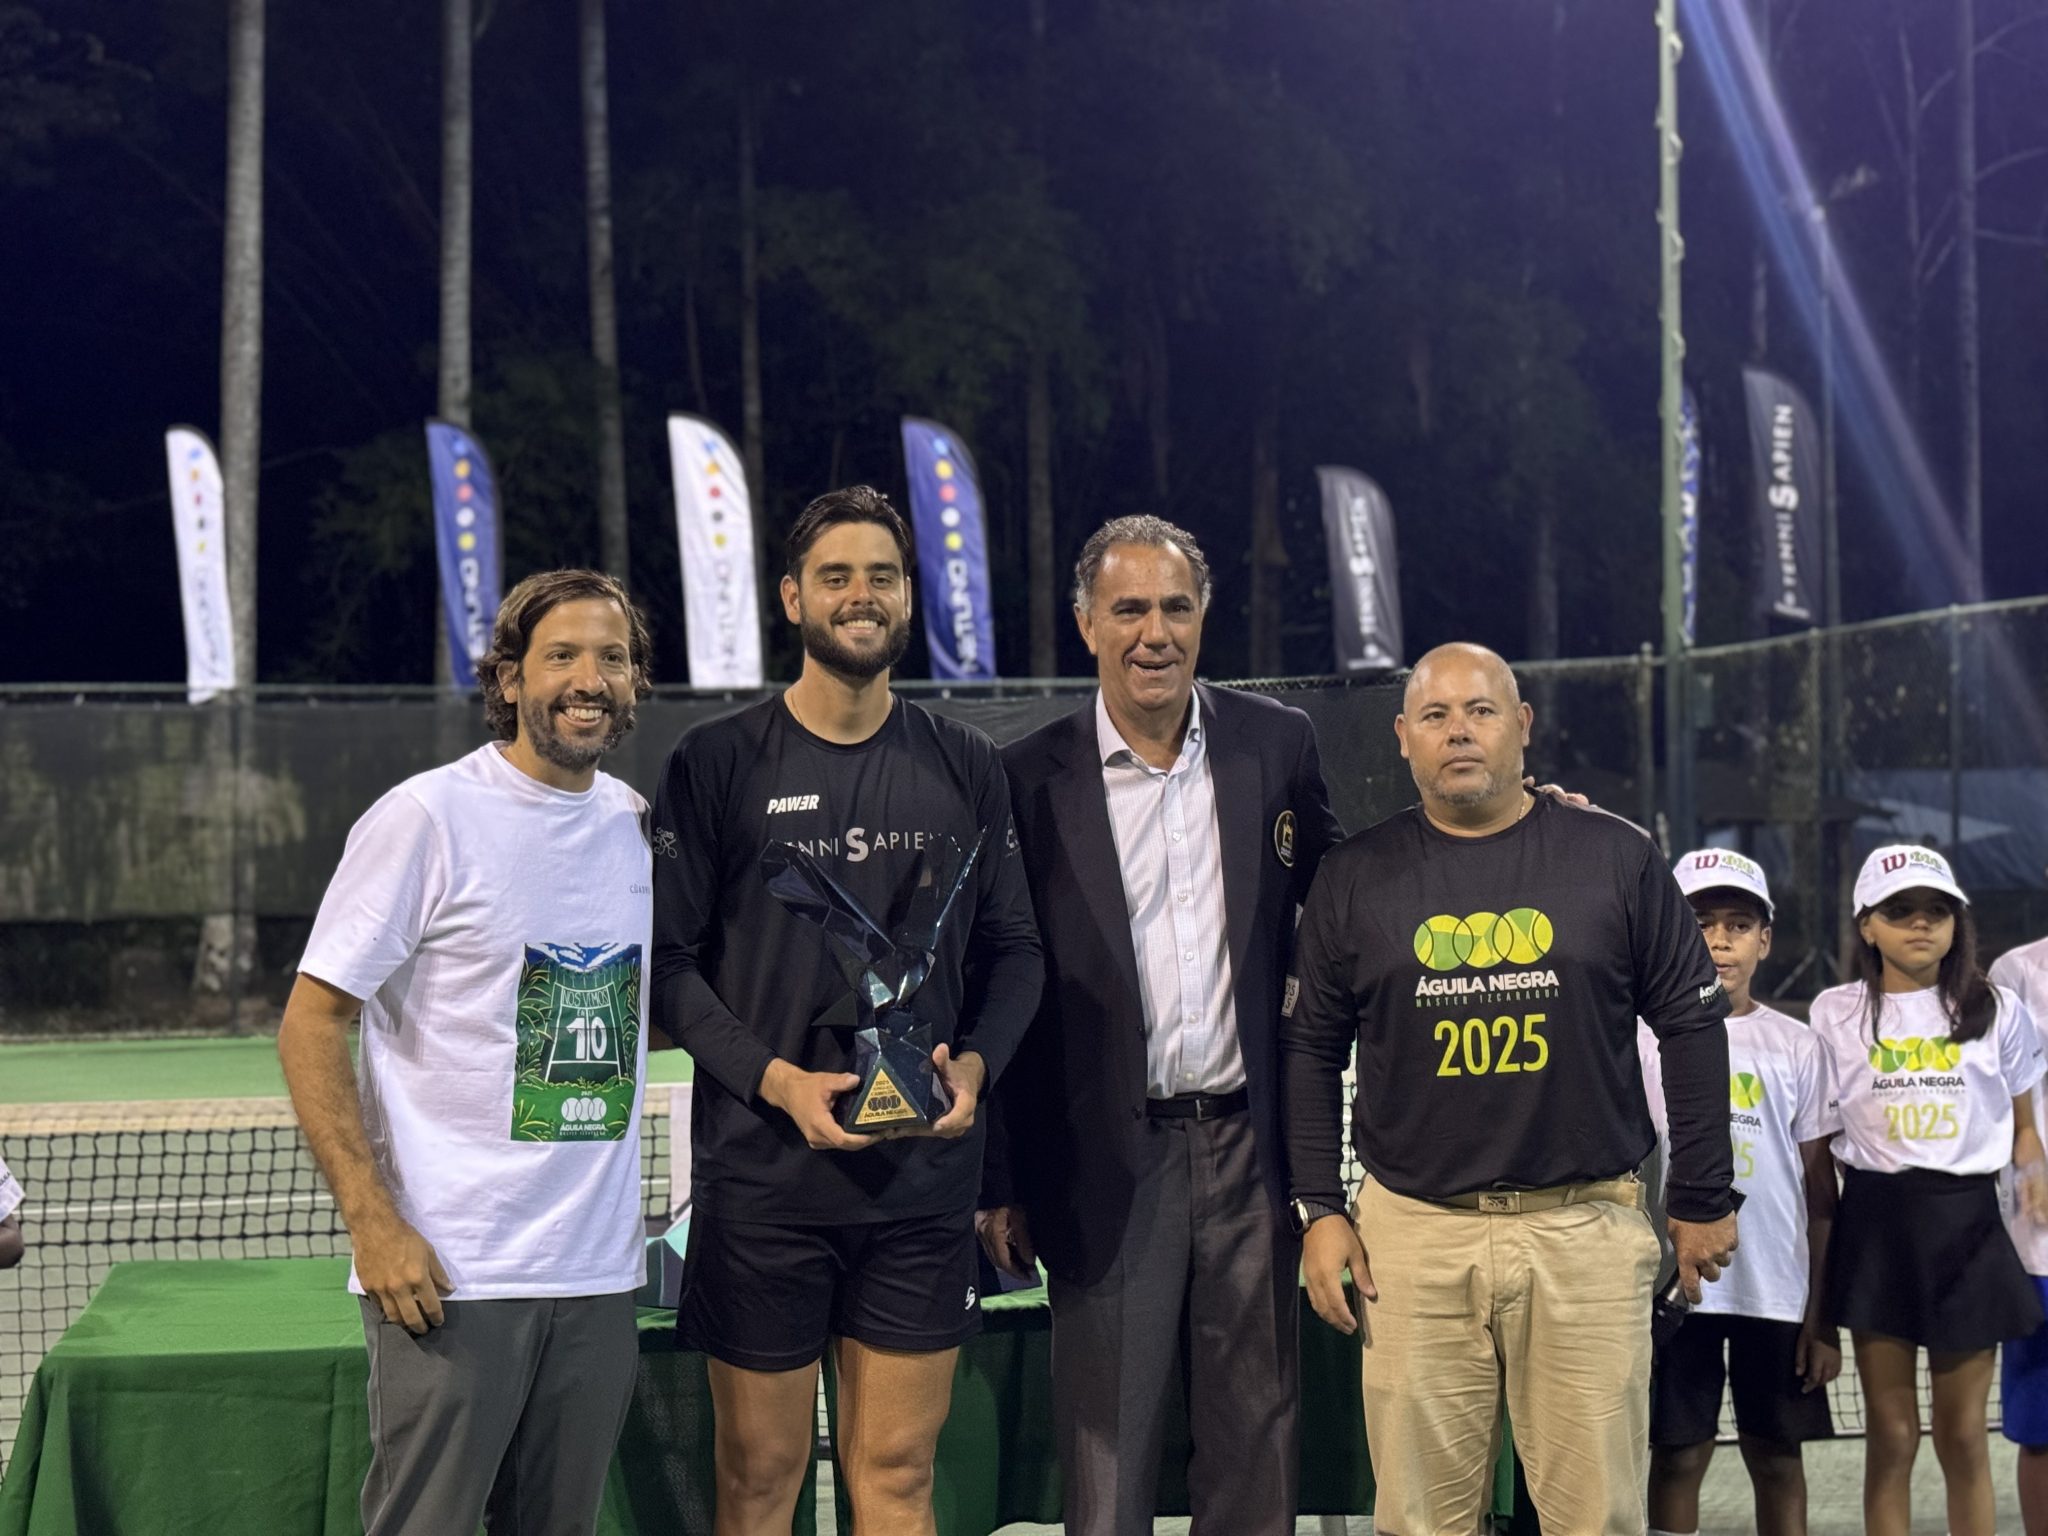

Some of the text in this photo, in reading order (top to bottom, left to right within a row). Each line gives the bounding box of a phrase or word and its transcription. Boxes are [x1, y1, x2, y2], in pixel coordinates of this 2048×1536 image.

[1415, 969, 1560, 997] ÁGUILA NEGRA
[1415, 996, 1468, 1008] MASTER
[566, 1016, 608, 1059] 10
[1434, 1013, 1549, 1077] 2025
[1872, 1076, 1966, 1091] ÁGUILA NEGRA
[1731, 1113, 1762, 1128] EGRA
[1884, 1103, 1960, 1141] 2025
